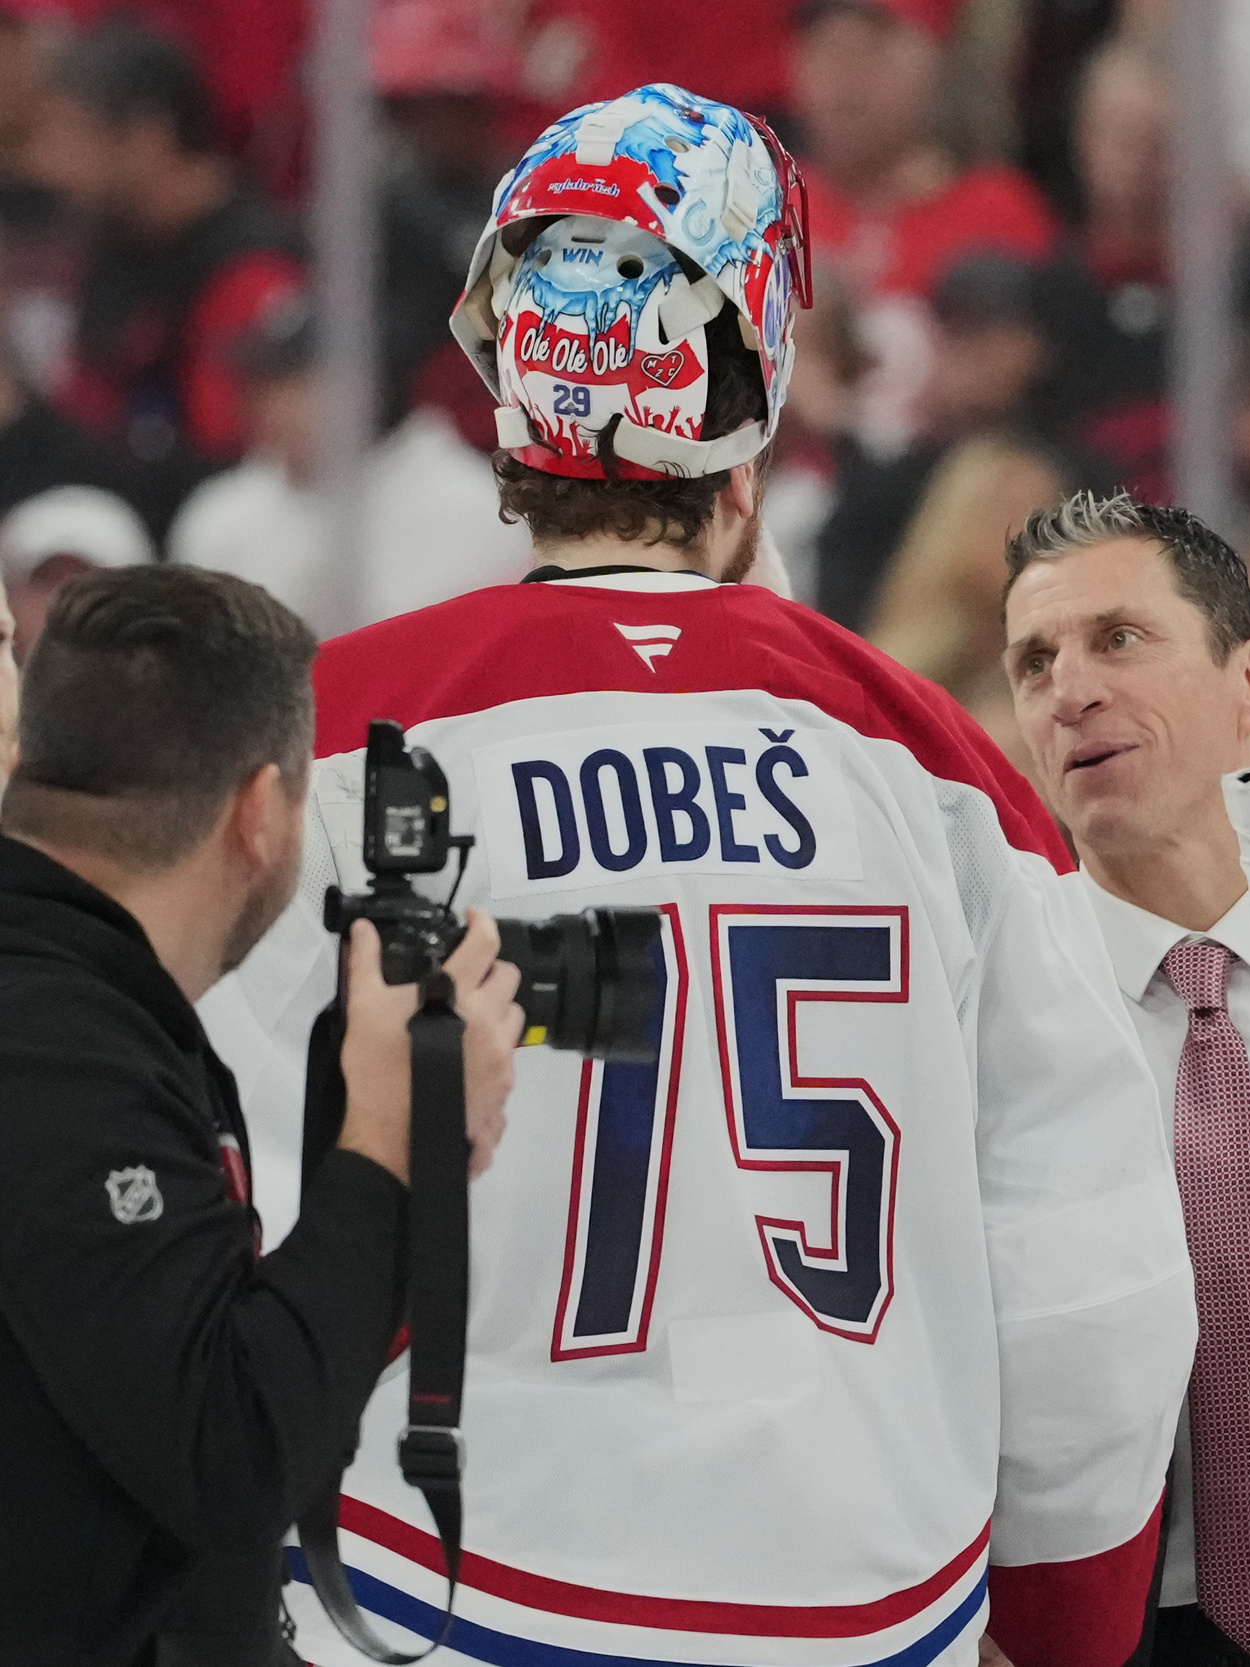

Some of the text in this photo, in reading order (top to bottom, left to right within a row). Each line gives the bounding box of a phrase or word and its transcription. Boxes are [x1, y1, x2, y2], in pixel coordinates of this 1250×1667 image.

[562, 248, 604, 267] WIN
[520, 327, 629, 376] Olé Olé Olé
[552, 383, 592, 418] 29
[511, 727, 817, 880] DOBEŠ
